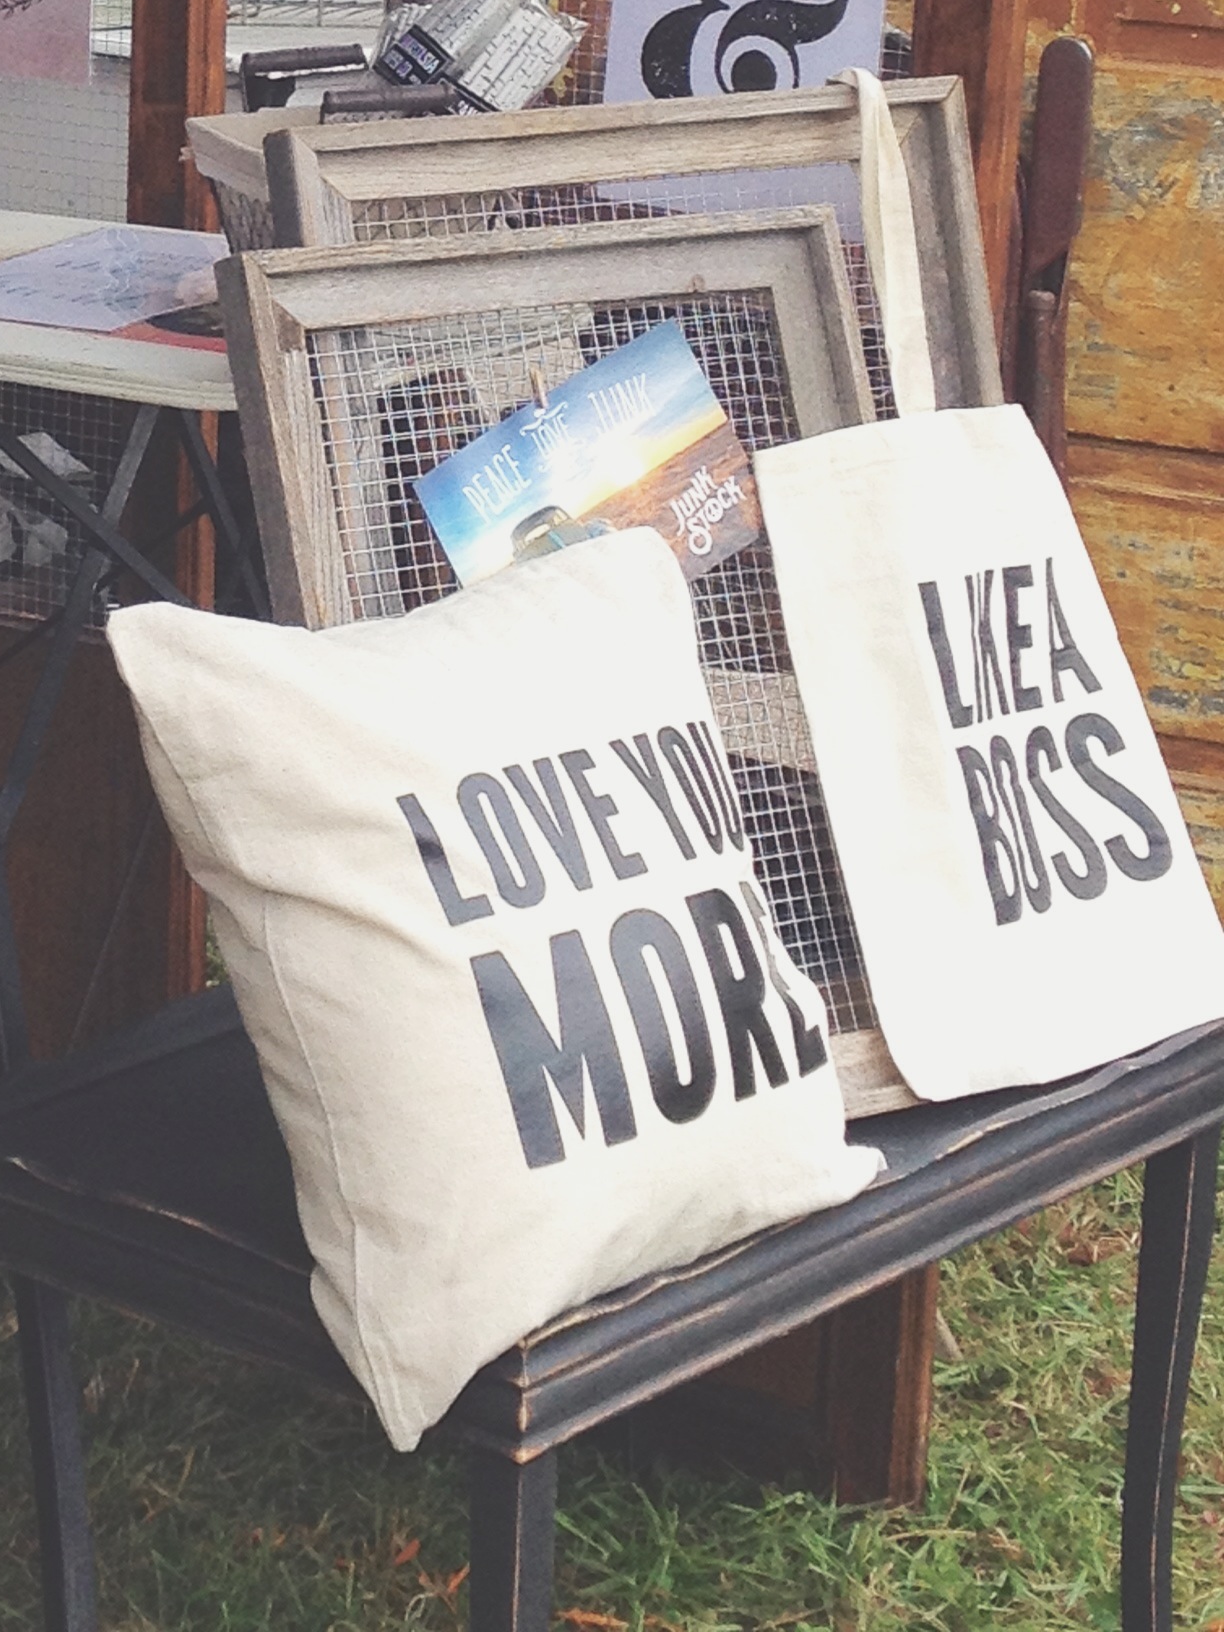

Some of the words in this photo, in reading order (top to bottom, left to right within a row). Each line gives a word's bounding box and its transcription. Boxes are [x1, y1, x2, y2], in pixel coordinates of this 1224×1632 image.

[462, 444, 532, 523] PEACE
[587, 373, 657, 436] JUNK
[669, 465, 718, 534] JUNK
[688, 475, 748, 556] STOCK
[919, 563, 1044, 729] LIKE
[1047, 558, 1103, 703] A
[397, 749, 648, 926] LOVE
[610, 720, 746, 861] YOU
[956, 712, 1174, 926] BOSS
[470, 880, 830, 1169] MORE
